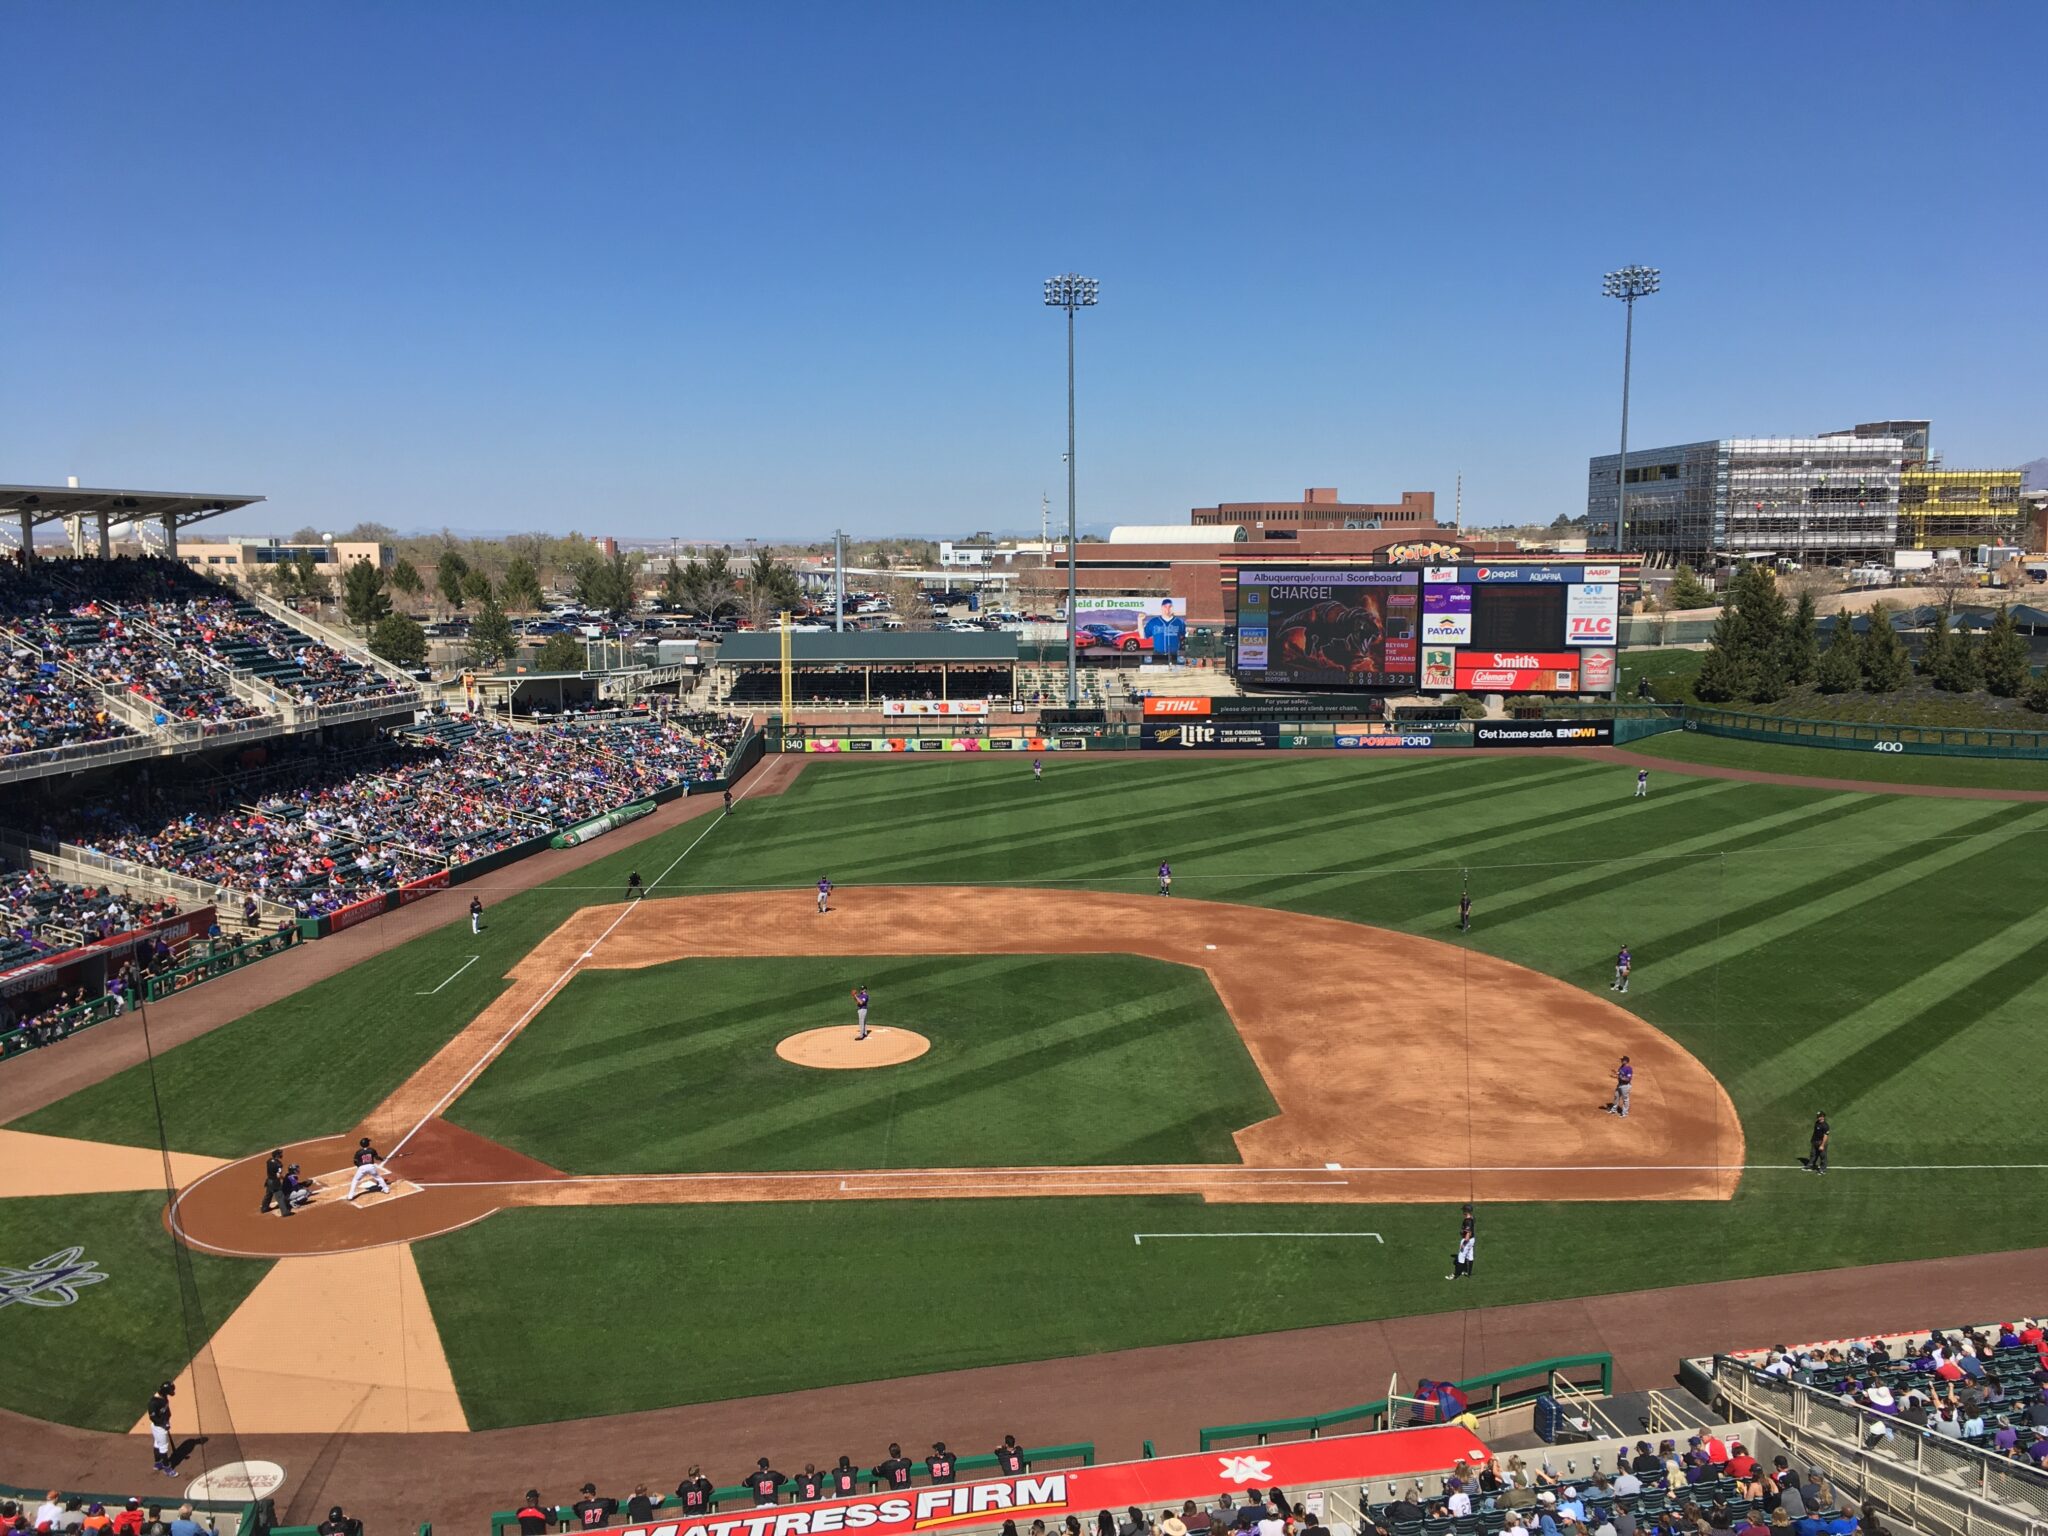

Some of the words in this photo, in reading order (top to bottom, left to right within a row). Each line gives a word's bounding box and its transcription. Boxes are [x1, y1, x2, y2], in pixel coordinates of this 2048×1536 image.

[1386, 542, 1461, 564] ISOTOPES
[1346, 573, 1402, 582] Scoreboard
[1491, 569, 1518, 580] pepsi
[1529, 572, 1562, 582] AQUAFINA
[1270, 586, 1332, 600] CHARGE!
[1449, 593, 1471, 602] metro
[1075, 600, 1092, 608] ield
[1095, 600, 1104, 608] of
[1106, 600, 1145, 608] Dreams
[1571, 617, 1612, 633] TLC
[1427, 627, 1466, 635] PAYDAY
[1493, 653, 1539, 668] Smith's
[1389, 675, 1396, 683] 3
[1398, 675, 1405, 683] 2
[1475, 672, 1507, 681] Coleman
[1154, 700, 1198, 711] STIHL
[1180, 725, 1215, 747] Lite
[1478, 729, 1497, 739] Get
[1498, 729, 1529, 739] home
[1529, 729, 1554, 739] safe.
[1556, 728, 1596, 738] ENDWI
[785, 740, 803, 749] 340
[1292, 736, 1307, 745] 371
[1873, 741, 1903, 752] 400
[895, 1468, 907, 1483] 11
[932, 1462, 950, 1478] 23
[759, 1480, 774, 1495] 12
[806, 1484, 815, 1498] 3
[687, 1491, 703, 1506] 21
[916, 1474, 1067, 1519] FIRM
[584, 1508, 603, 1524] 27
